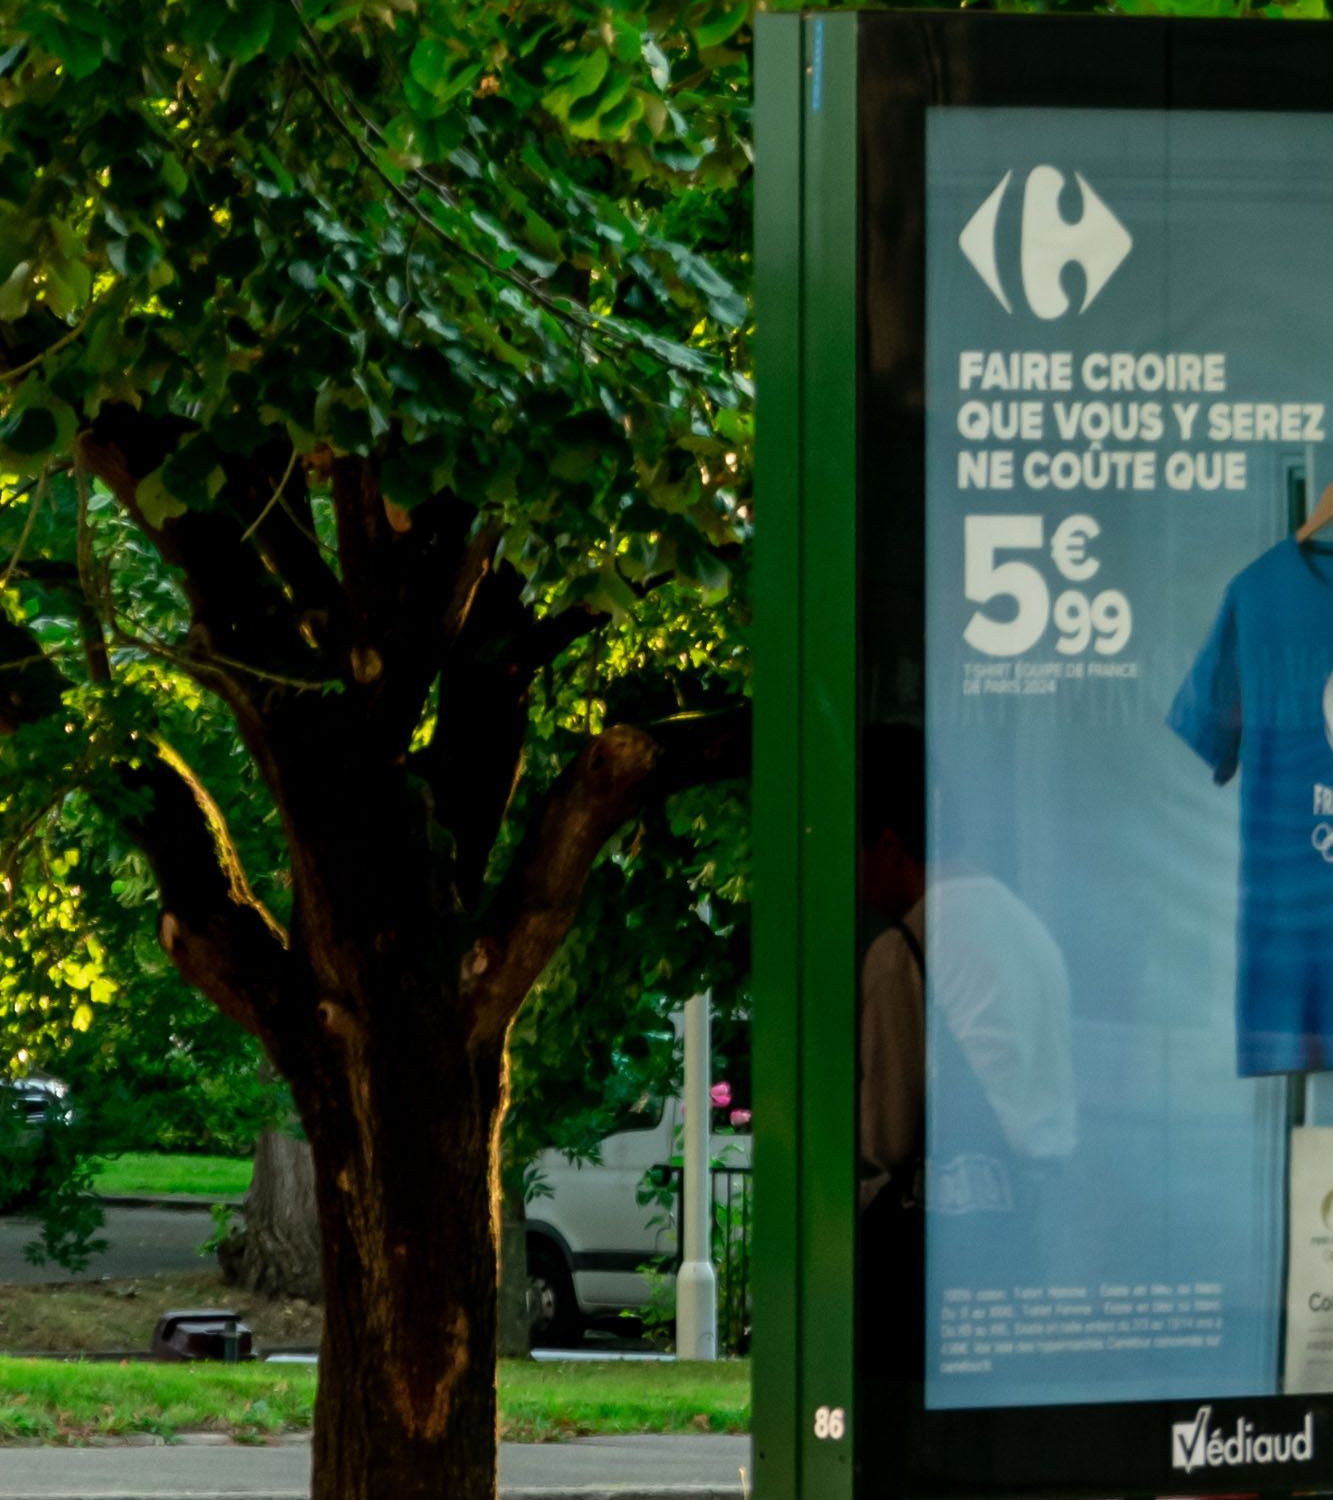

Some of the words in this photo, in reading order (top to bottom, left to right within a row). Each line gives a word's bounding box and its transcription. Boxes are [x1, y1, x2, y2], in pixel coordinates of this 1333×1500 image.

[959, 351, 1073, 391] FAIRE
[1081, 352, 1226, 393] CROIRE
[956, 400, 1044, 442] QUE
[1053, 401, 1164, 442] VOUS
[1172, 402, 1199, 441] Y
[1207, 402, 1326, 442] SEREZ
[957, 450, 1015, 490] NE
[1023, 440, 1156, 490] COÛTE
[1165, 451, 1247, 491] QUE
[814, 1405, 845, 1440] 86
